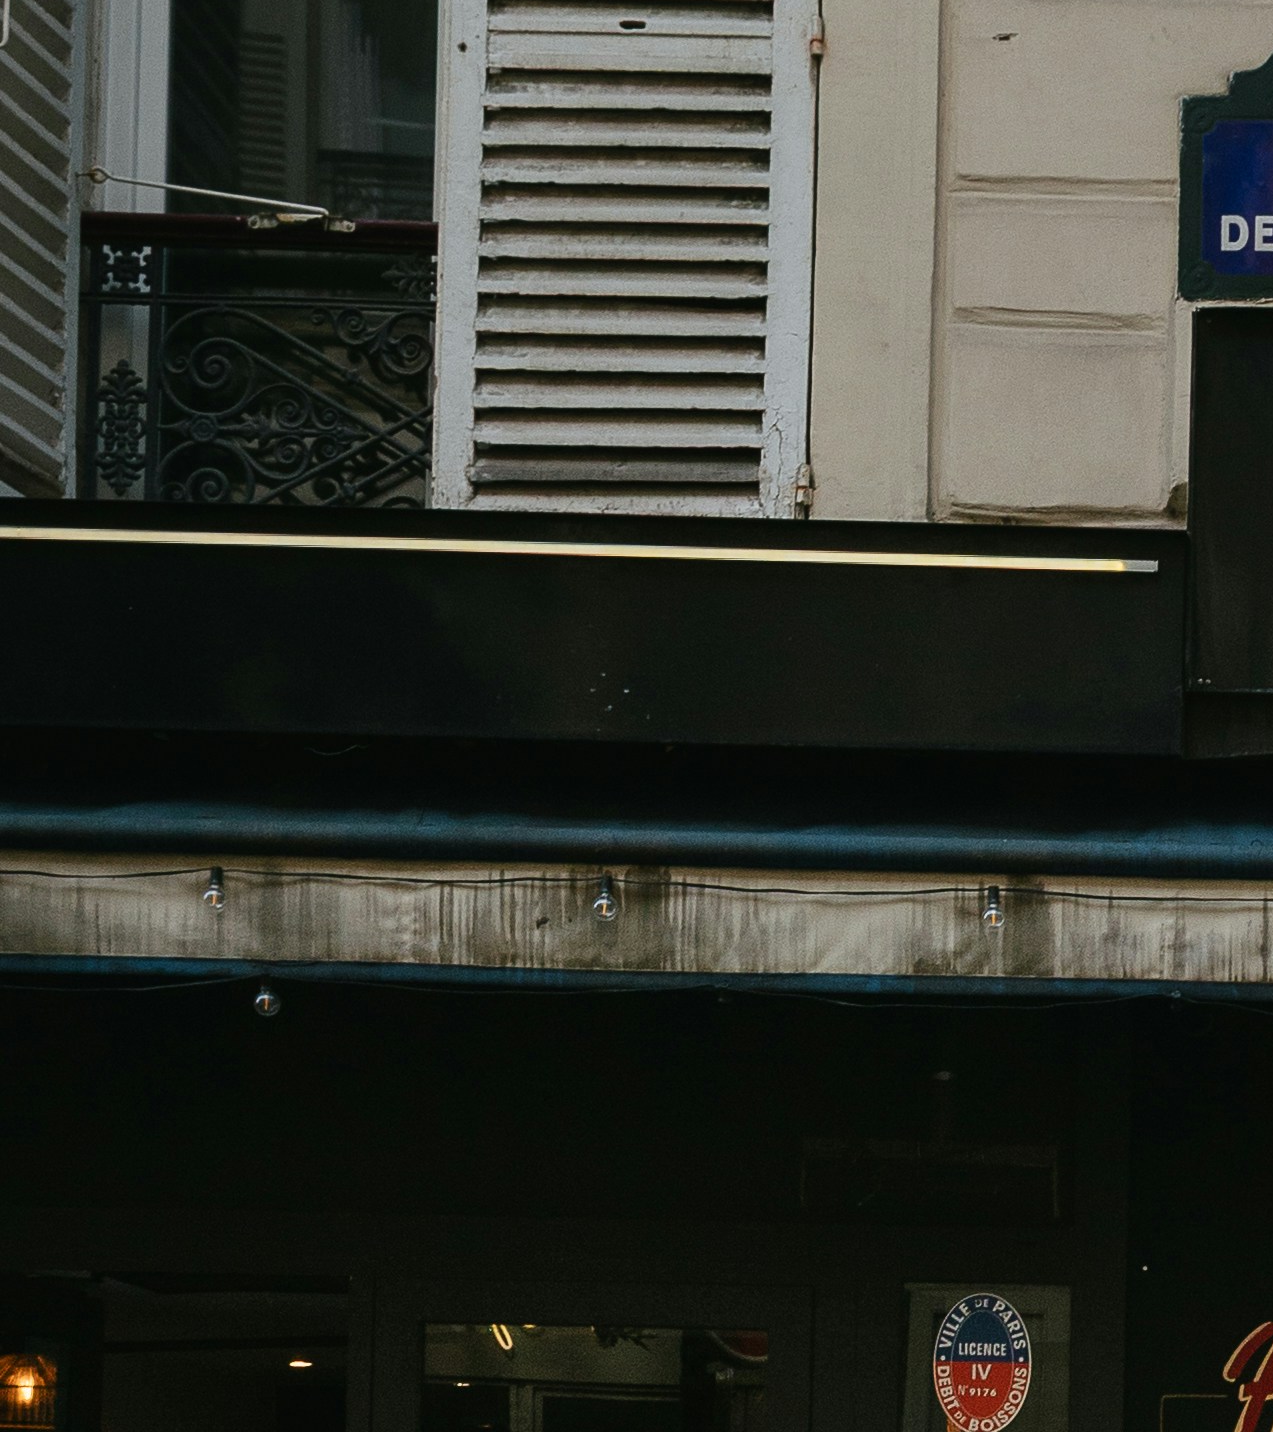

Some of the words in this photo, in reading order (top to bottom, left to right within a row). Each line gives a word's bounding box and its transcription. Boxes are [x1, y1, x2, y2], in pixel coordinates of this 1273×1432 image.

[938, 1301, 972, 1350] VILLE
[974, 1298, 990, 1309] DE
[991, 1300, 1027, 1350] PARIS
[958, 1342, 1007, 1358] LICENCE
[970, 1363, 992, 1382] IV
[936, 1365, 959, 1412] DEBIT
[954, 1409, 967, 1424] DE
[967, 1367, 1028, 1432] BOISSONS
